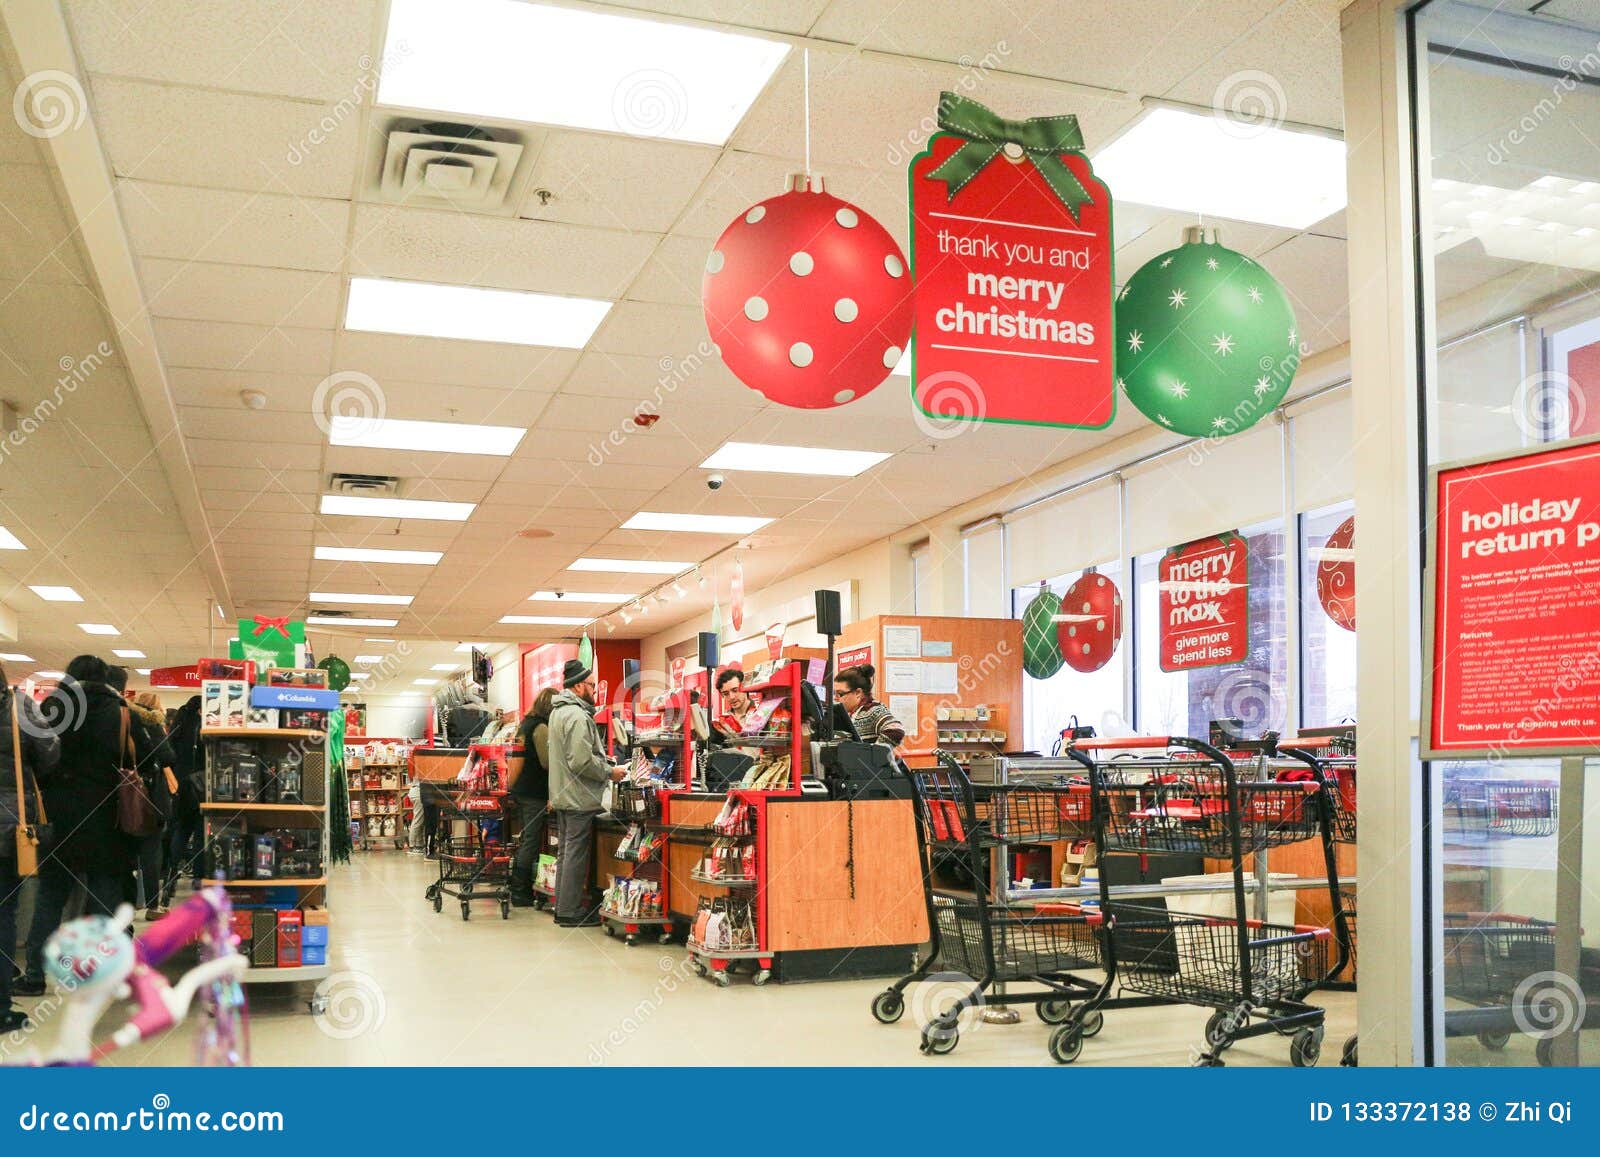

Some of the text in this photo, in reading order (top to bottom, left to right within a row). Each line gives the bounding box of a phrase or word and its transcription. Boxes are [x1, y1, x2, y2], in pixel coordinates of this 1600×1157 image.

[937, 229, 1090, 270] thank you and
[967, 272, 1065, 310] merry
[935, 302, 1095, 346] christmas
[1461, 497, 1582, 533] holiday
[1461, 523, 1600, 559] return p
[1169, 551, 1236, 581] merry
[1585, 557, 1600, 567] hav
[1169, 576, 1231, 605] to the
[1170, 601, 1225, 626] maxx
[1172, 646, 1232, 665] spend less
[1176, 631, 1229, 651] give more
[284, 694, 317, 704] Columbia
[1456, 717, 1598, 732] Thank you for shopping with us.
